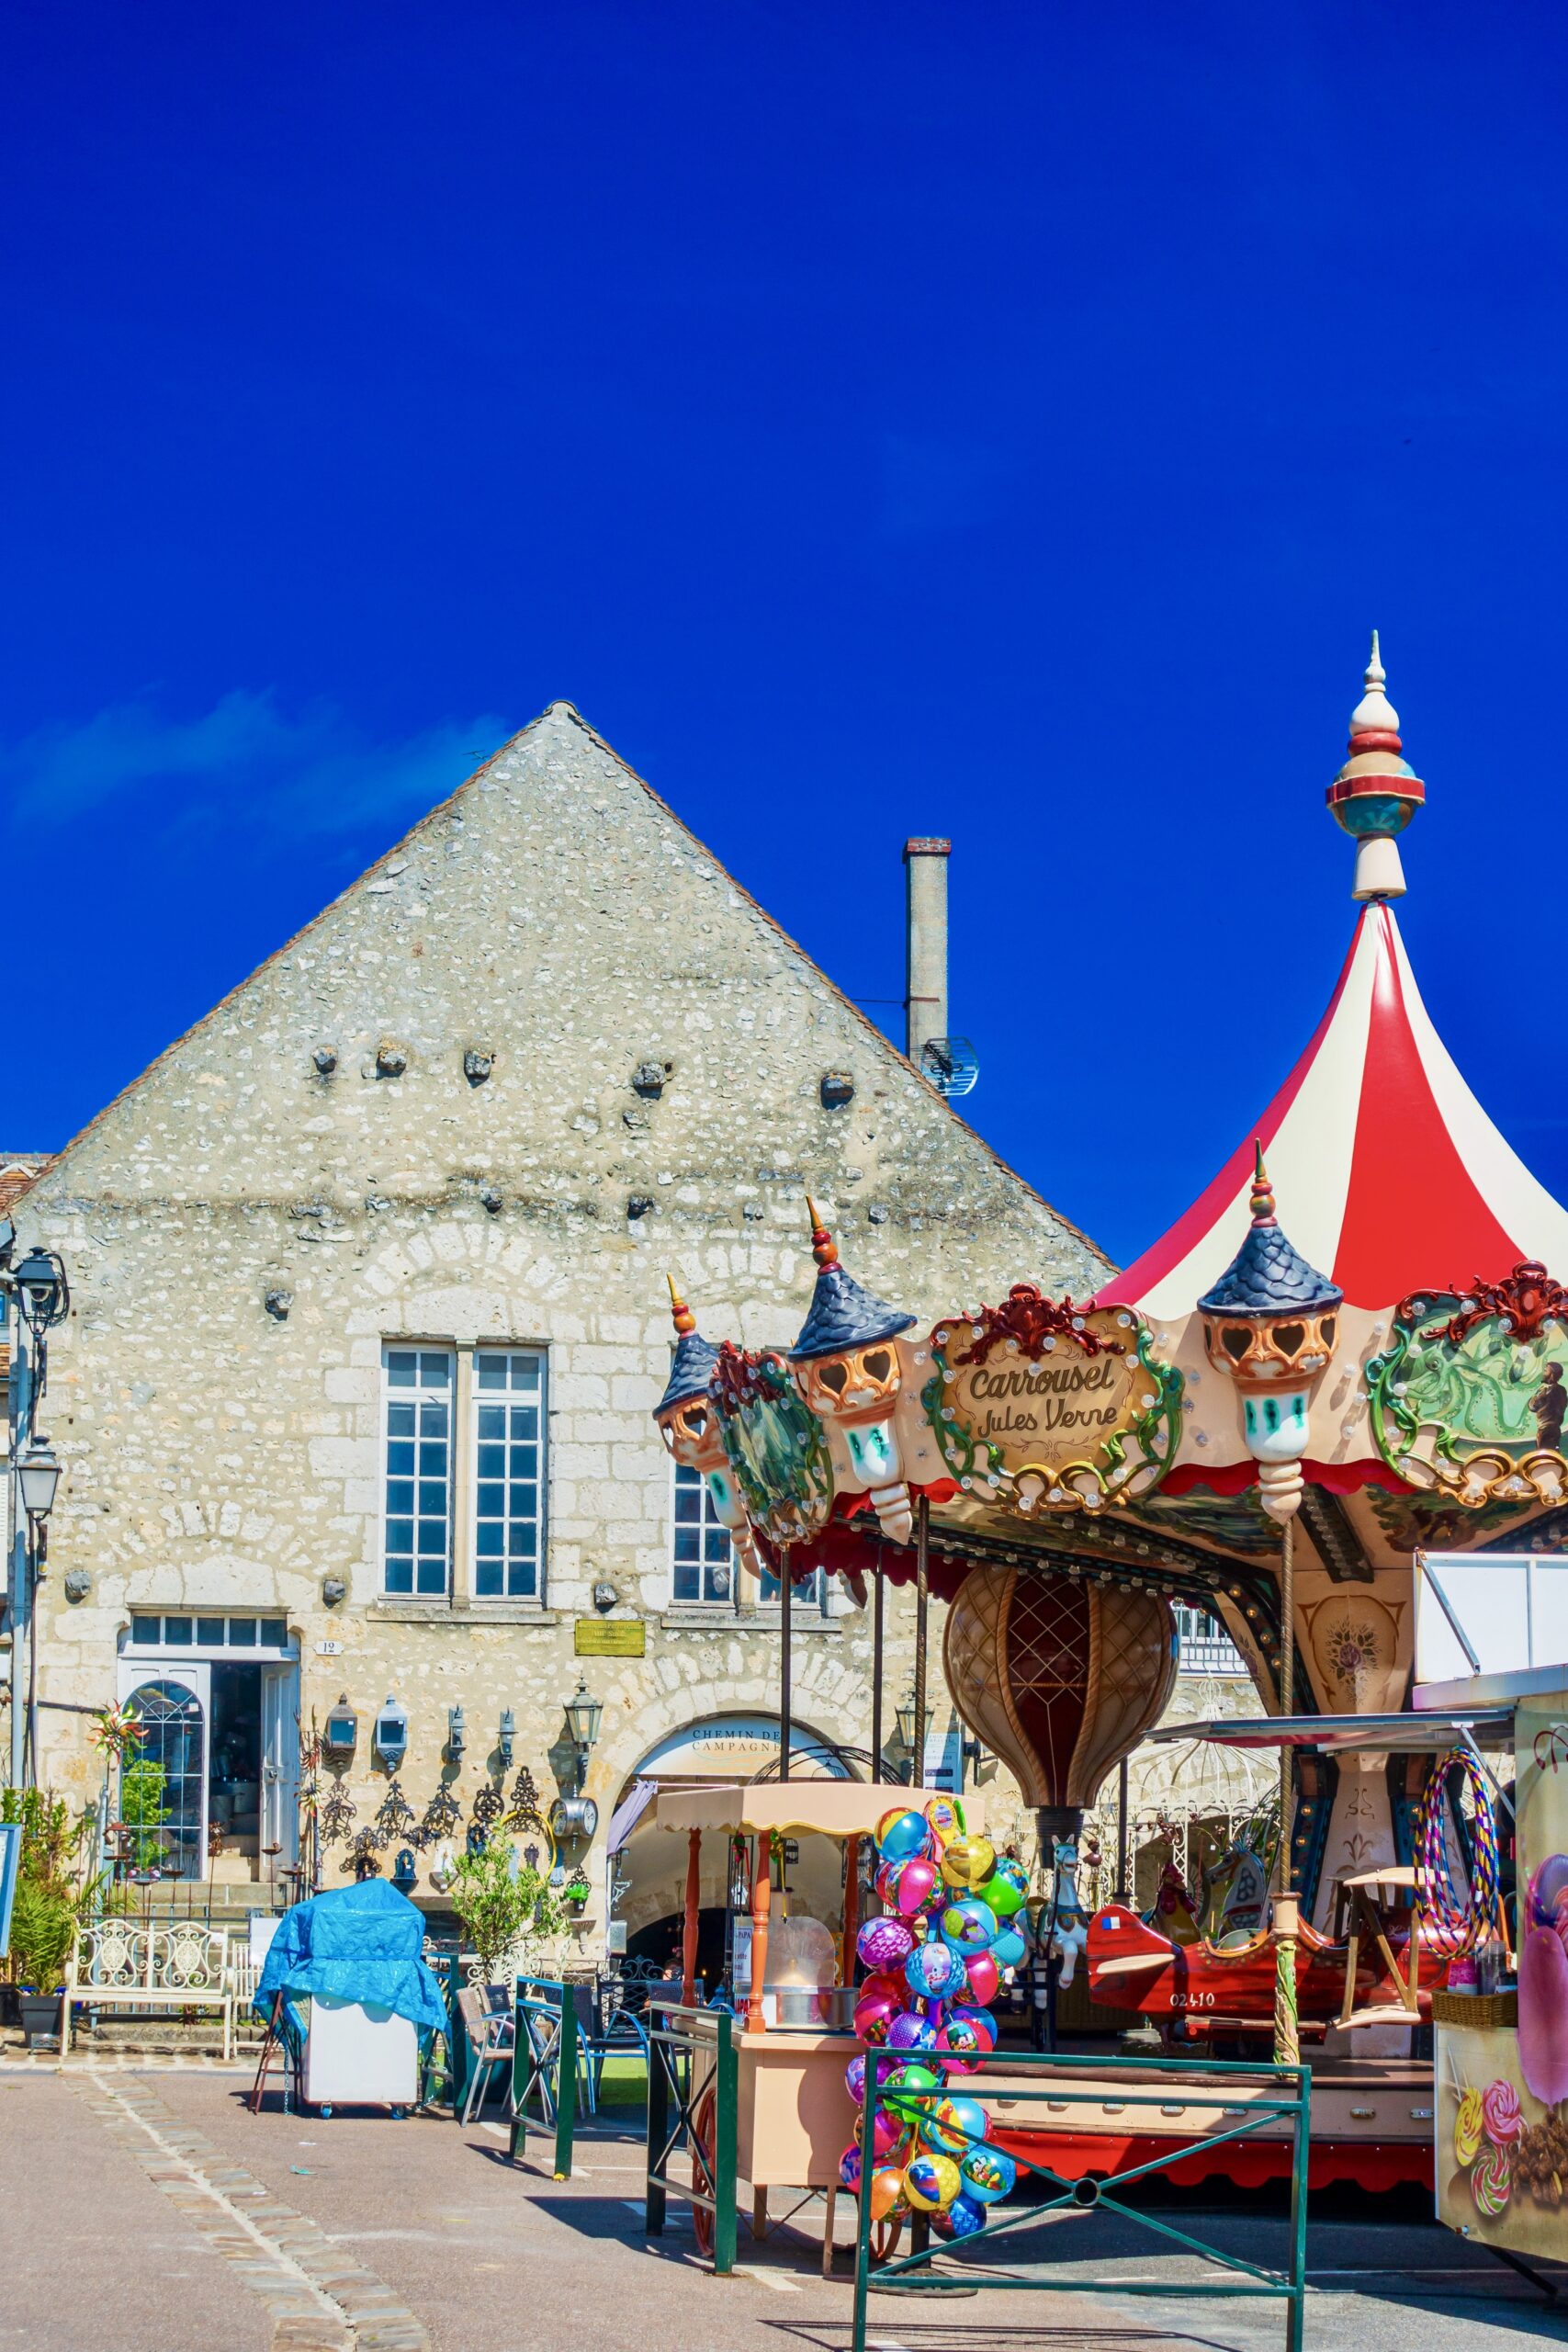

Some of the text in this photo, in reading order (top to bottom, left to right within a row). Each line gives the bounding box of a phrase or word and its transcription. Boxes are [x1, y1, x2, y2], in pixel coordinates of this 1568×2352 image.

[969, 1358, 1115, 1399] Carrousel
[977, 1398, 1118, 1439] Jules Verne
[323, 1642, 334, 1653] 12
[692, 1729, 781, 1740] CHEMIN DE
[692, 1742, 782, 1752] CAMPAGNE
[1169, 1992, 1215, 2007] 02410
